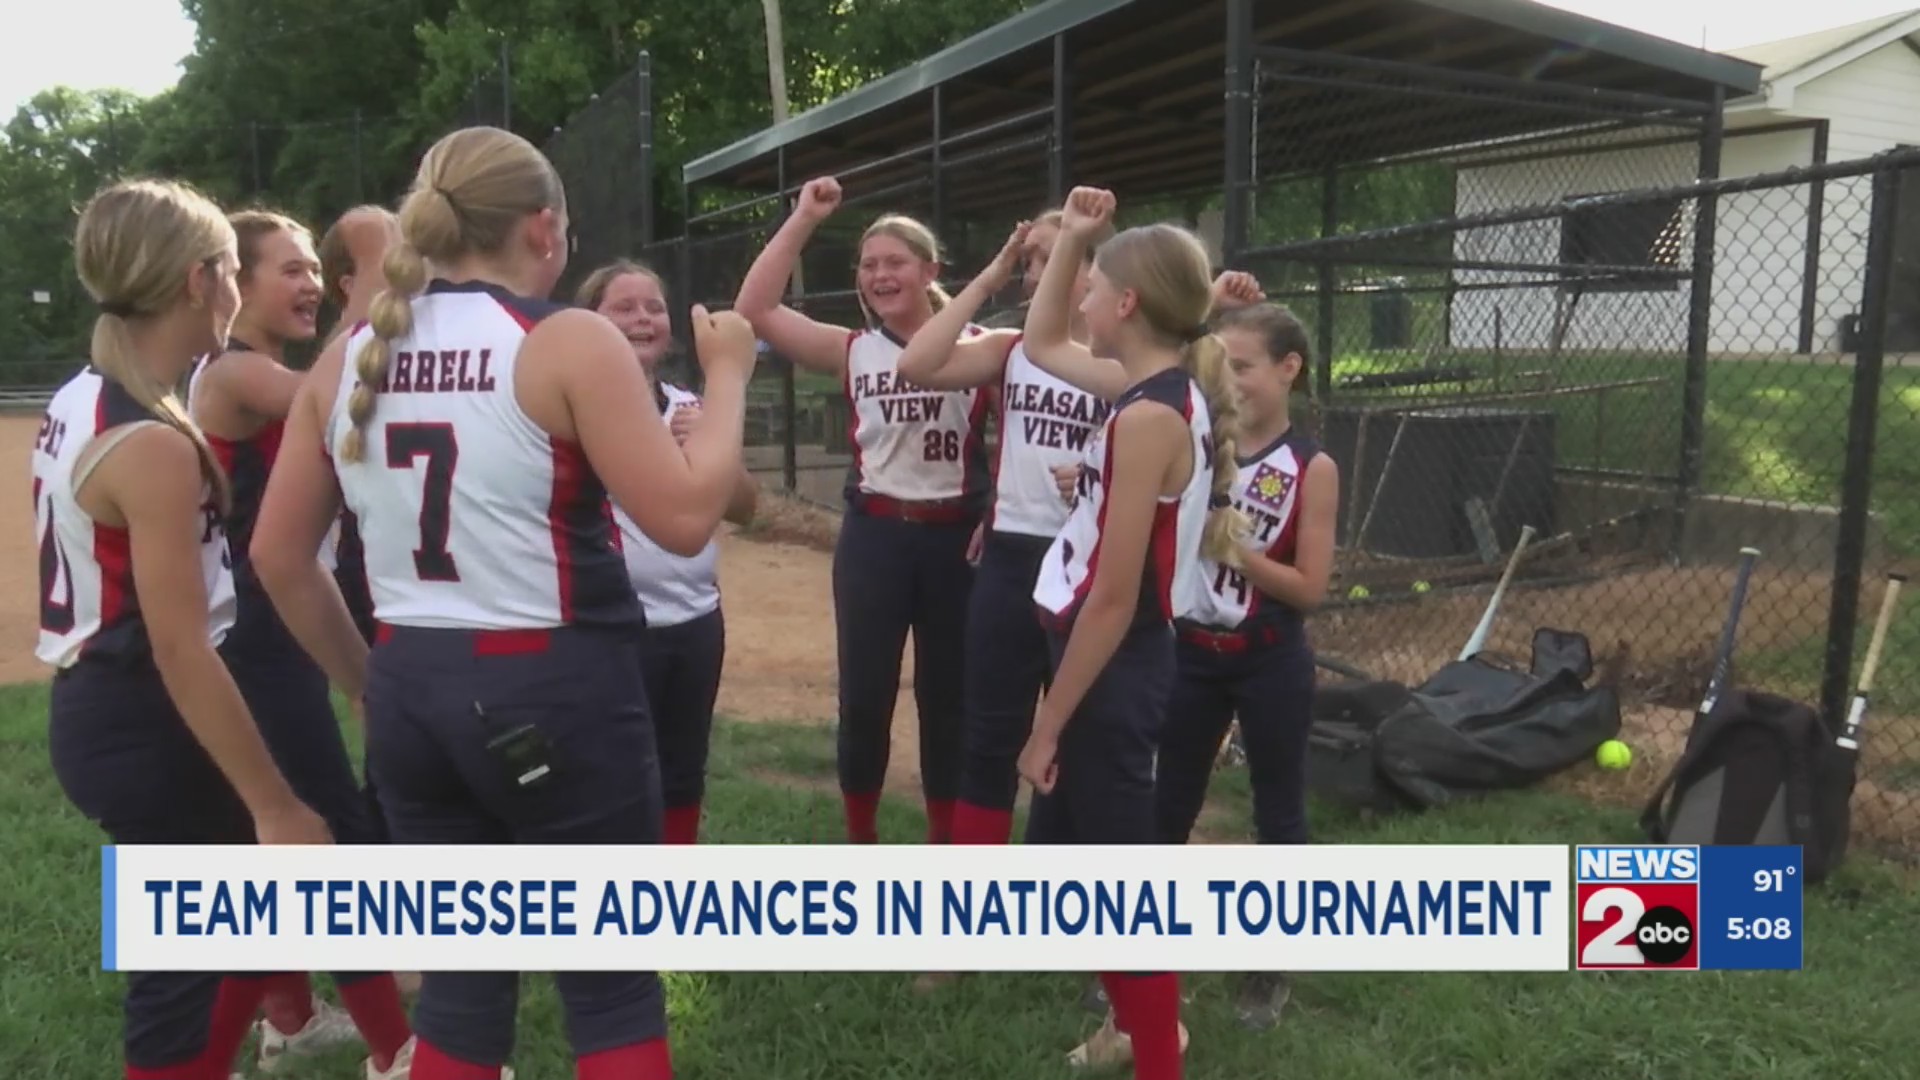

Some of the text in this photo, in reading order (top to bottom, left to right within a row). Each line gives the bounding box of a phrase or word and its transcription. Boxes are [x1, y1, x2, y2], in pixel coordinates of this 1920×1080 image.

[879, 396, 944, 424] VIEW
[923, 429, 959, 462] 26
[1023, 415, 1092, 453] VIEW
[385, 421, 461, 582] 7
